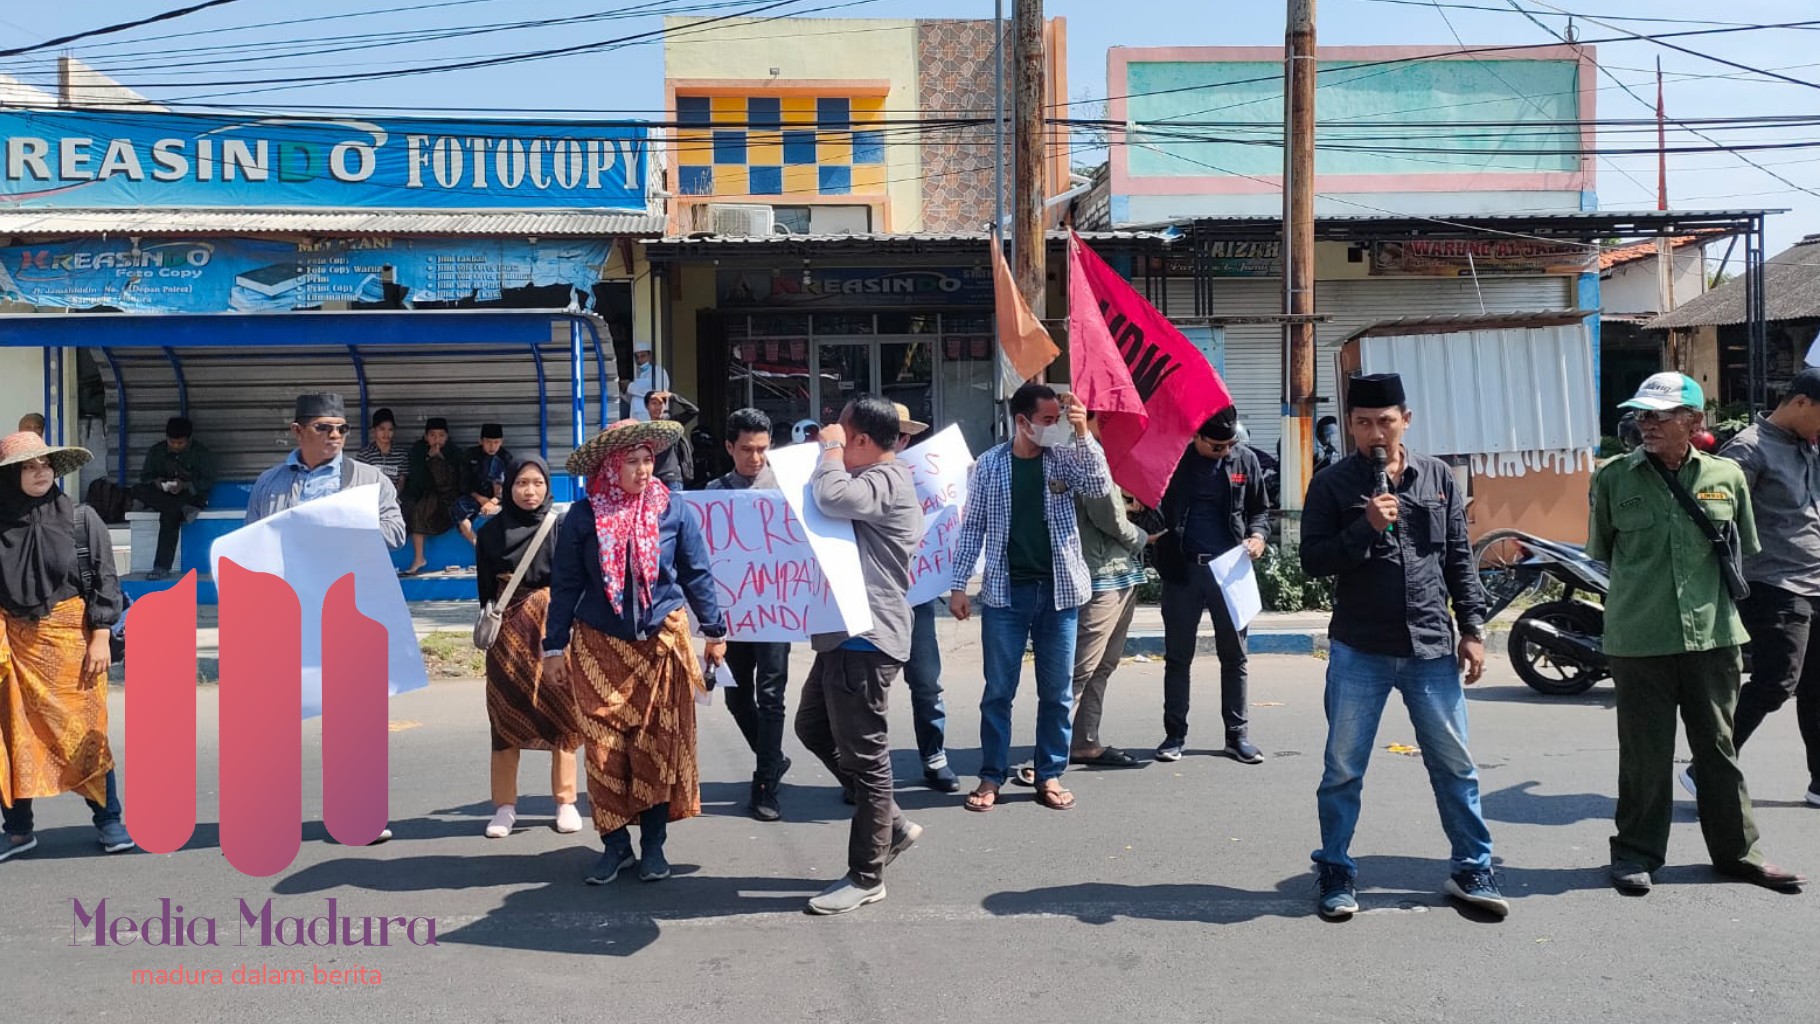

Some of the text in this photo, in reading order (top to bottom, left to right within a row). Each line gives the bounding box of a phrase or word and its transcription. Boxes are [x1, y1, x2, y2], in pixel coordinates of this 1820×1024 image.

[405, 133, 643, 190] FOTOCOPY
[1412, 240, 1492, 257] WARUNG
[20, 249, 211, 270] KREASINDO
[115, 268, 203, 279] Foto Copy
[306, 266, 326, 274] Foto
[329, 266, 350, 275] Copy
[770, 274, 961, 295] KREASINDO
